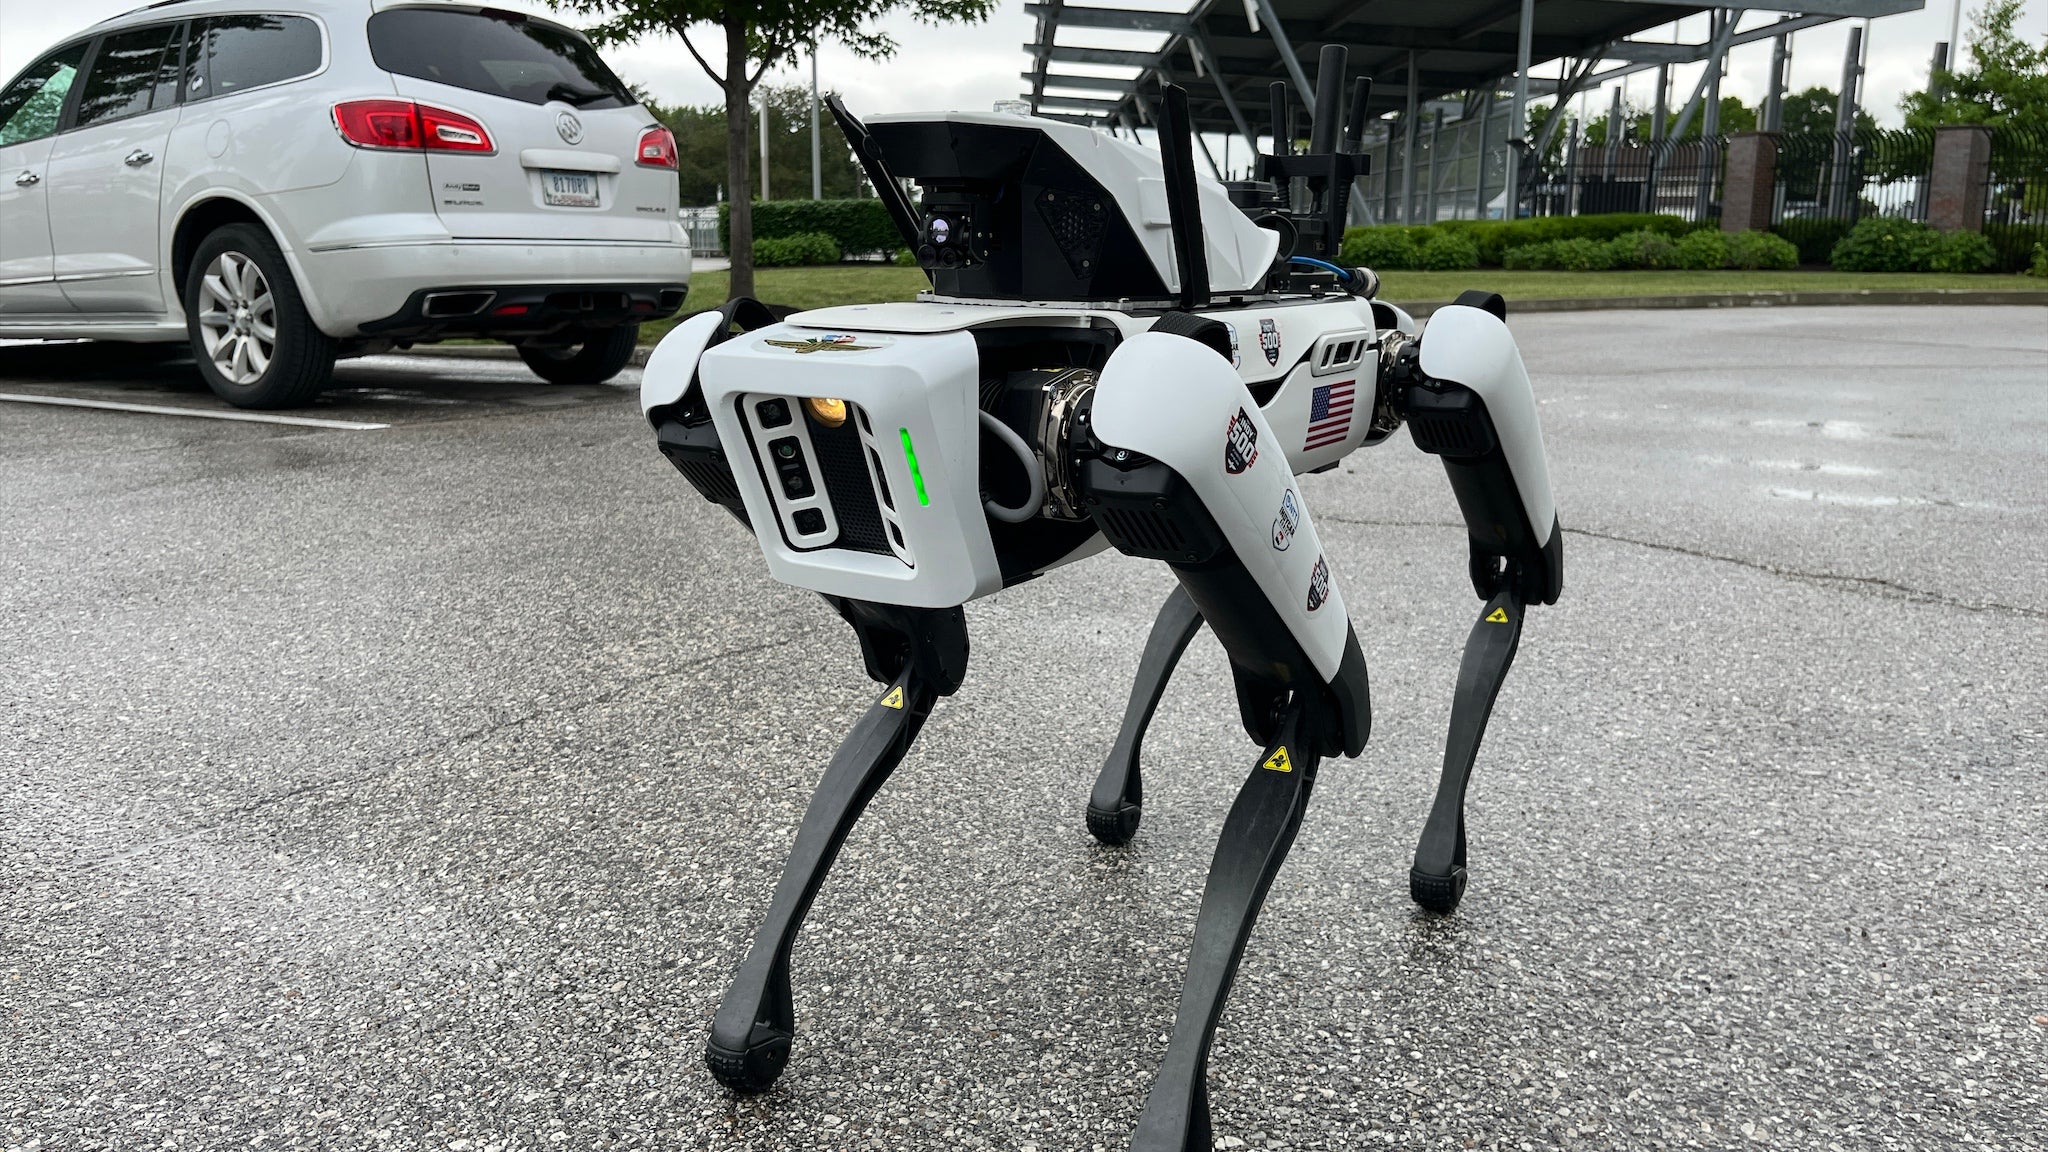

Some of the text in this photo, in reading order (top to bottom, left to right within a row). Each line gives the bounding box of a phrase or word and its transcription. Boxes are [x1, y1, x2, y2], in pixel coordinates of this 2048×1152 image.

[1262, 332, 1278, 350] 500
[1229, 421, 1255, 464] 500
[1240, 417, 1254, 439] INDY
[1279, 506, 1296, 538] INDYCAR
[1312, 567, 1328, 601] 500
